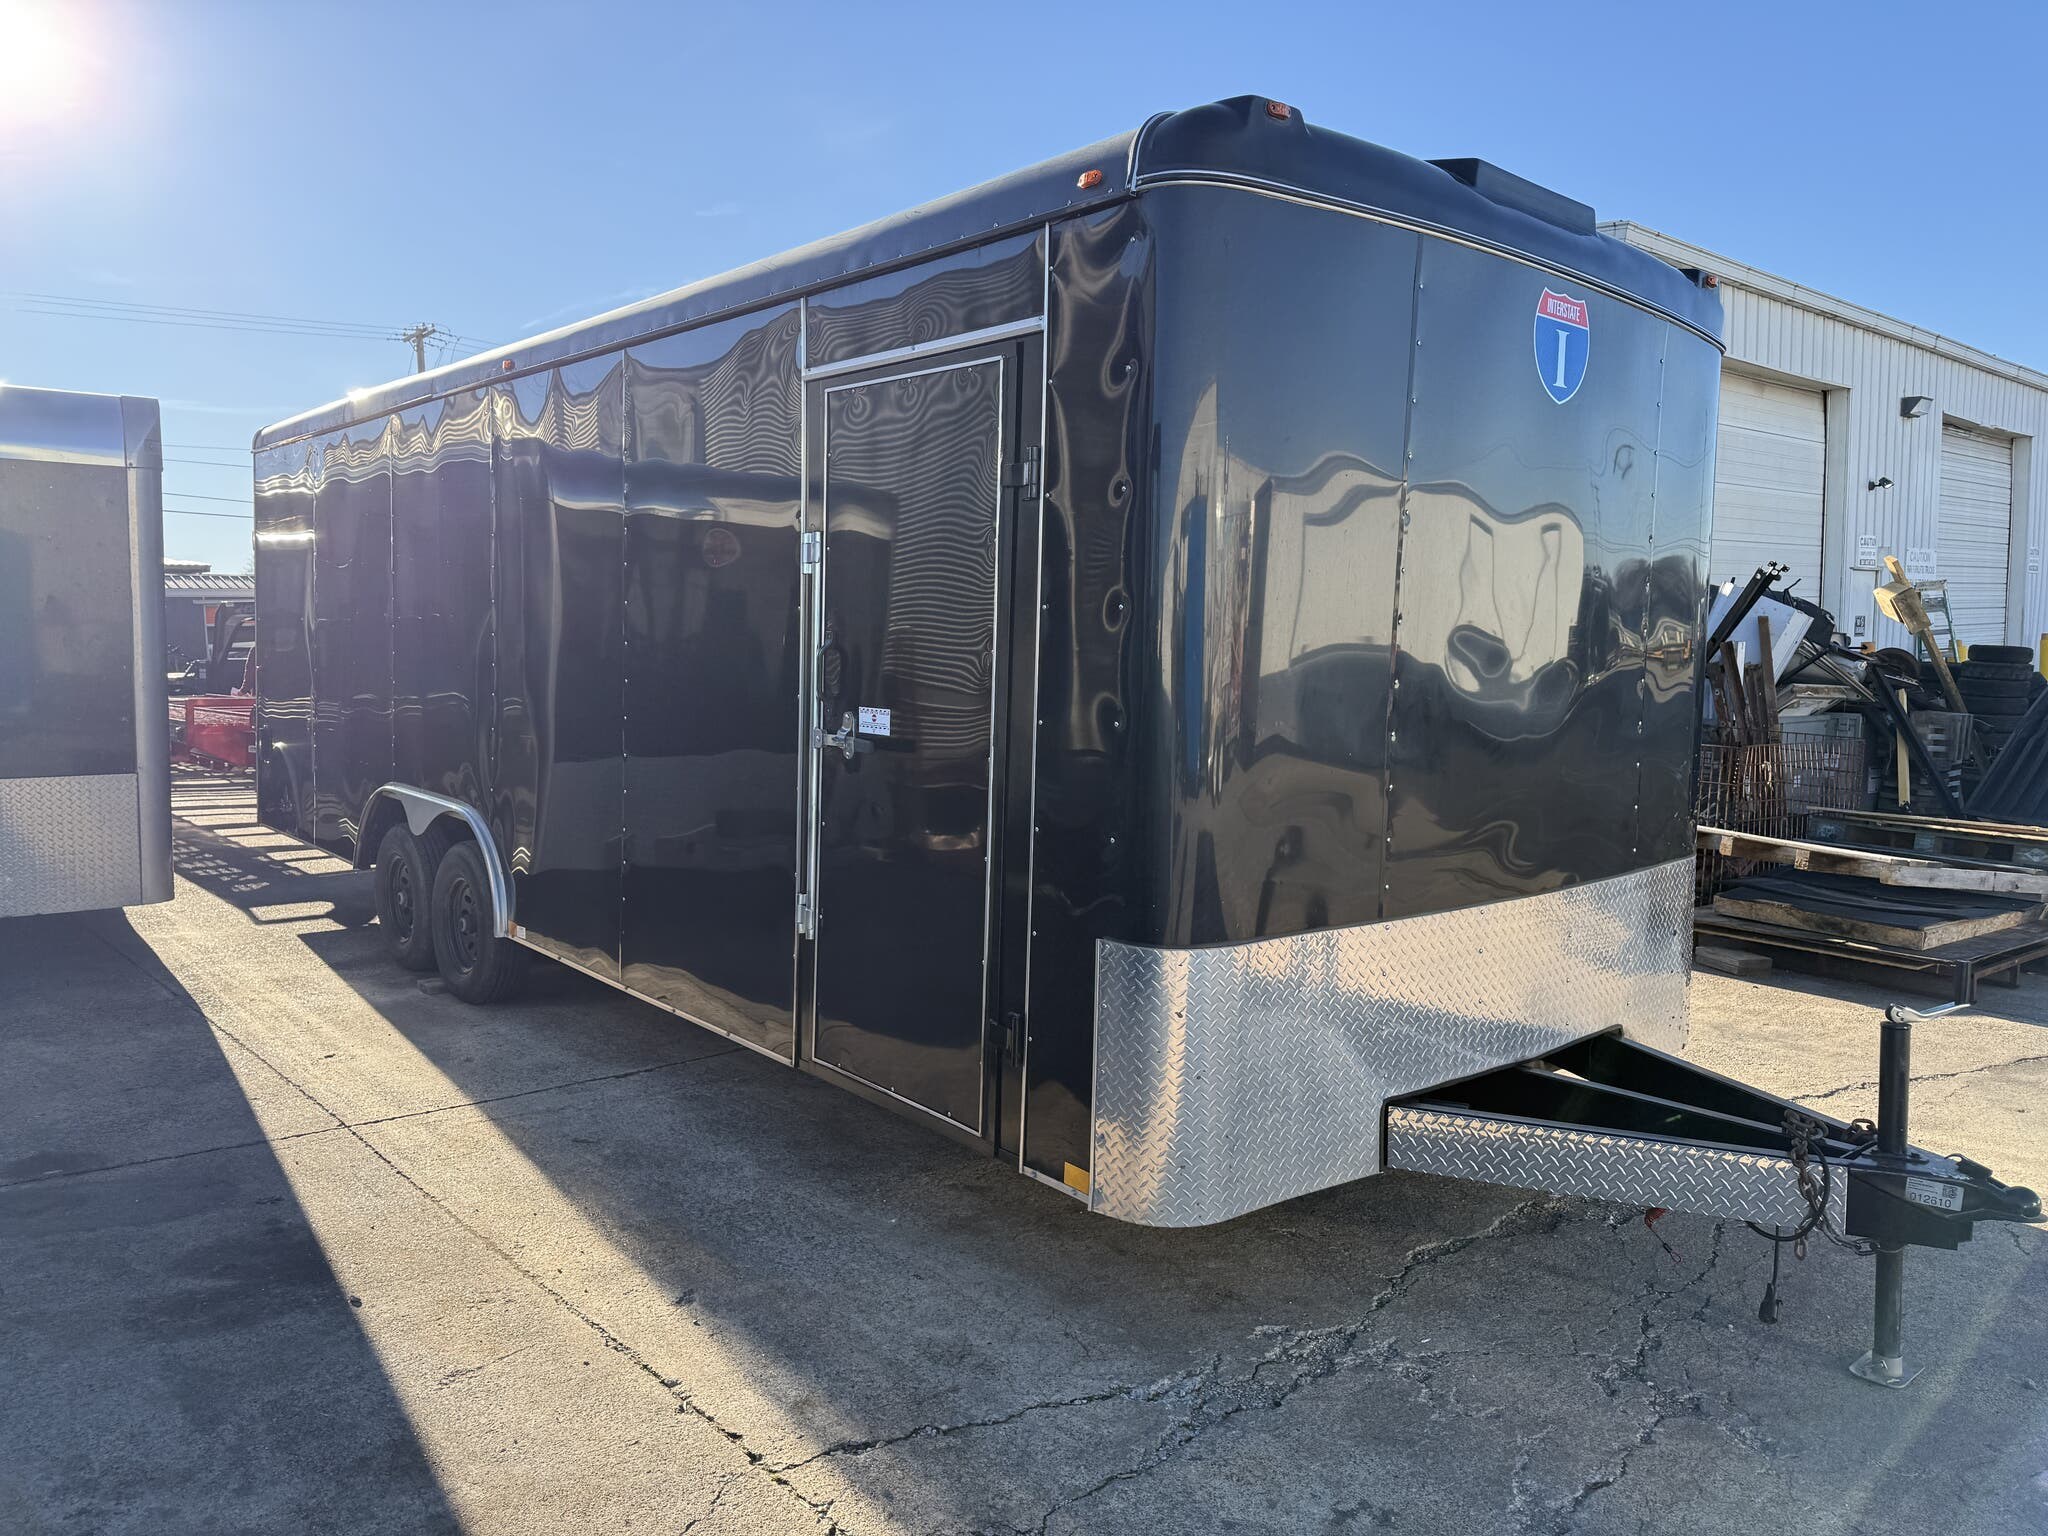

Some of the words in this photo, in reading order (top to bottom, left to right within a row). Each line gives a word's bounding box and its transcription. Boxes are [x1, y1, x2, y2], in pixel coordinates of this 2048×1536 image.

[1547, 298, 1581, 322] INTERSTATE
[1553, 329, 1570, 388] I
[1910, 1192, 1952, 1208] 012610
